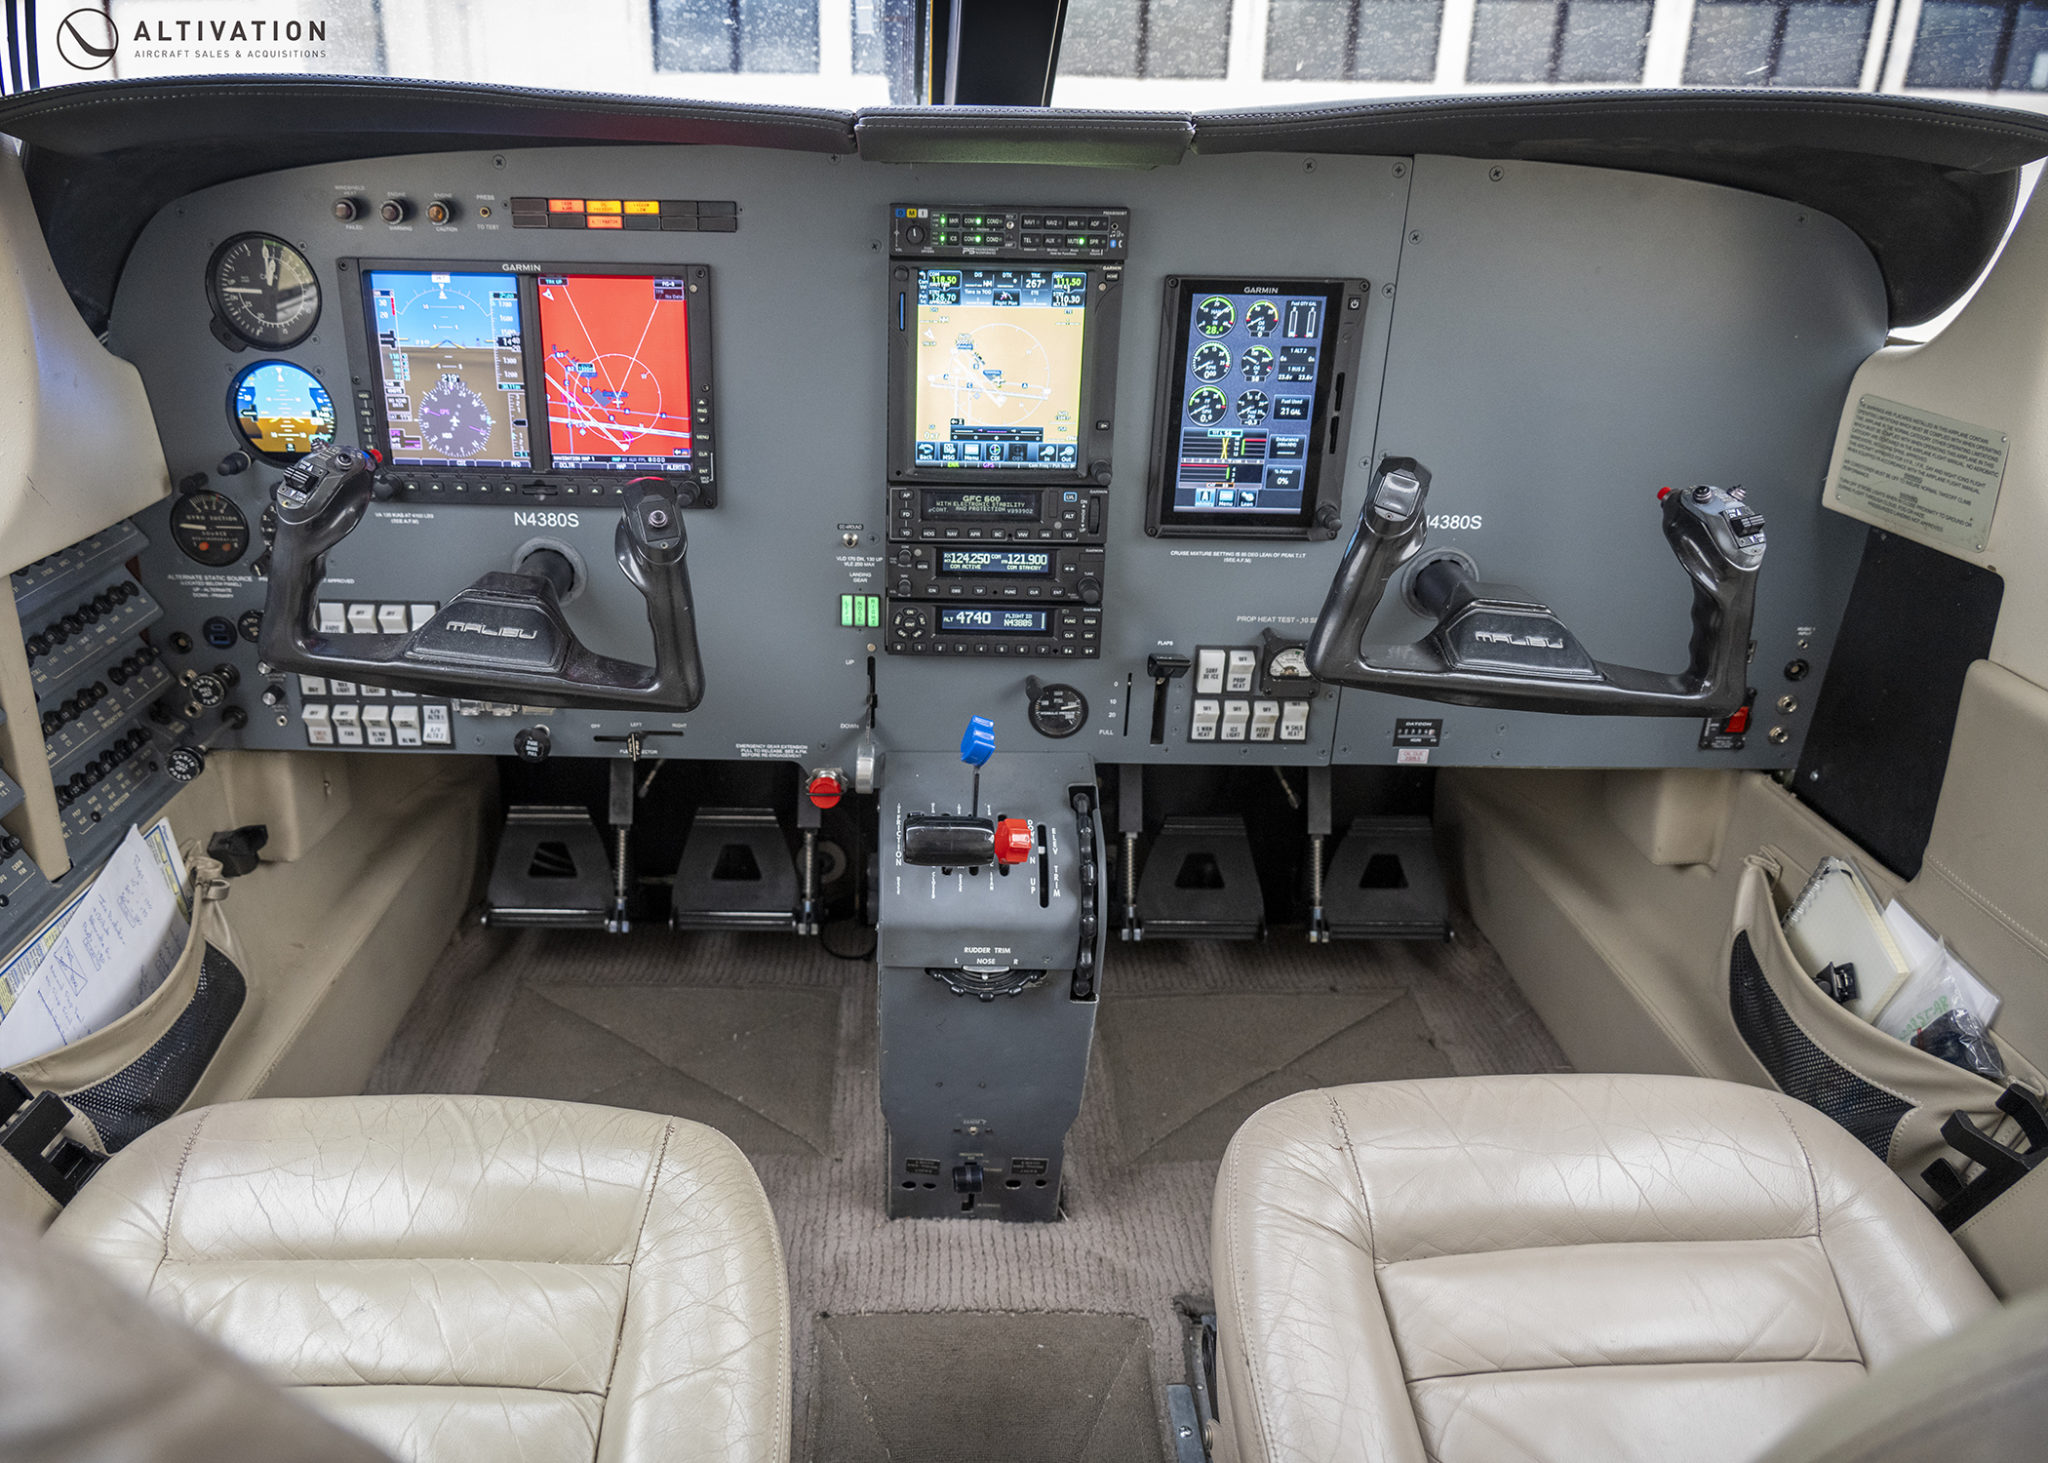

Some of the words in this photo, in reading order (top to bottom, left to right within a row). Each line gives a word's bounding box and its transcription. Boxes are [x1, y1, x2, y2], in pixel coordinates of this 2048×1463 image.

[502, 263, 541, 272] GARMIN
[932, 276, 957, 284] 118.50
[1025, 279, 1046, 289] 267°
[1057, 278, 1081, 286] 111.50
[1243, 286, 1279, 294] GARMIN
[932, 293, 957, 302] 126.70
[1206, 325, 1223, 334] 28.4
[1276, 477, 1289, 485] 0%
[513, 511, 580, 528] N4380S
[1007, 554, 1048, 565] 121.900
[204, 574, 226, 582] STATIC
[226, 575, 253, 583] SOURCE
[956, 611, 992, 624] 4740
[1004, 619, 1033, 627] N4380S
[446, 620, 538, 640] MALIBU
[1474, 631, 1564, 649] MALIBU
[172, 755, 195, 767] CABIN
[1053, 865, 1061, 897] TRIM
[1030, 878, 1036, 895] UP
